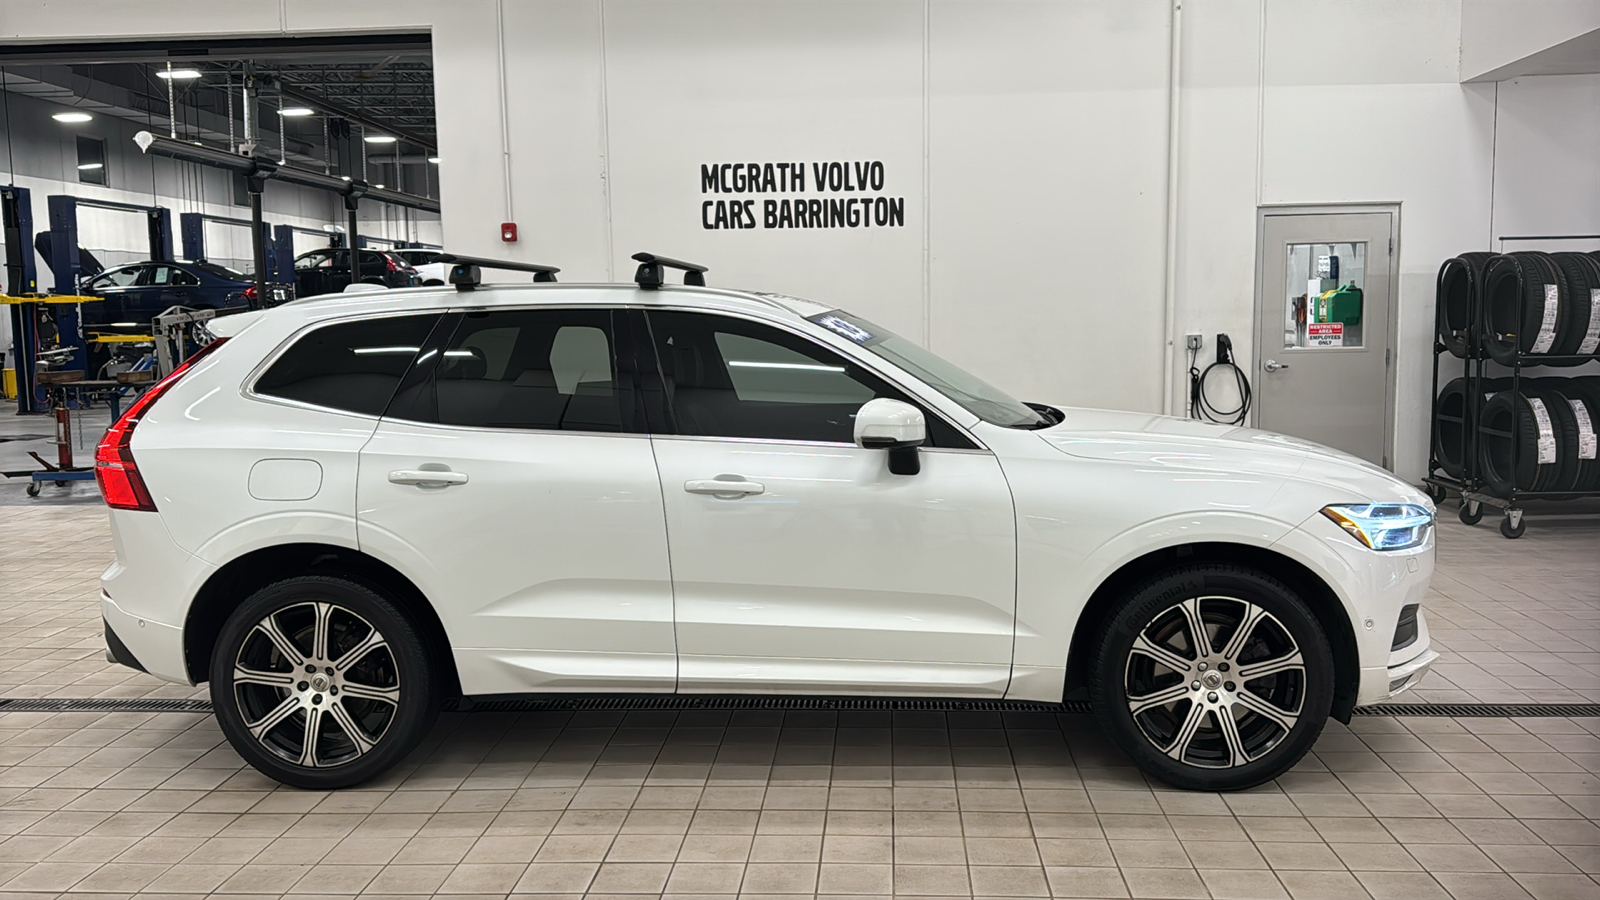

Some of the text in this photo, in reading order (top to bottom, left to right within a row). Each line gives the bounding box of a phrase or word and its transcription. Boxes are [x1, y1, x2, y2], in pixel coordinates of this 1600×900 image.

[701, 161, 884, 193] MCGRATH VOLVO
[702, 197, 904, 229] CARS BARRINGTON
